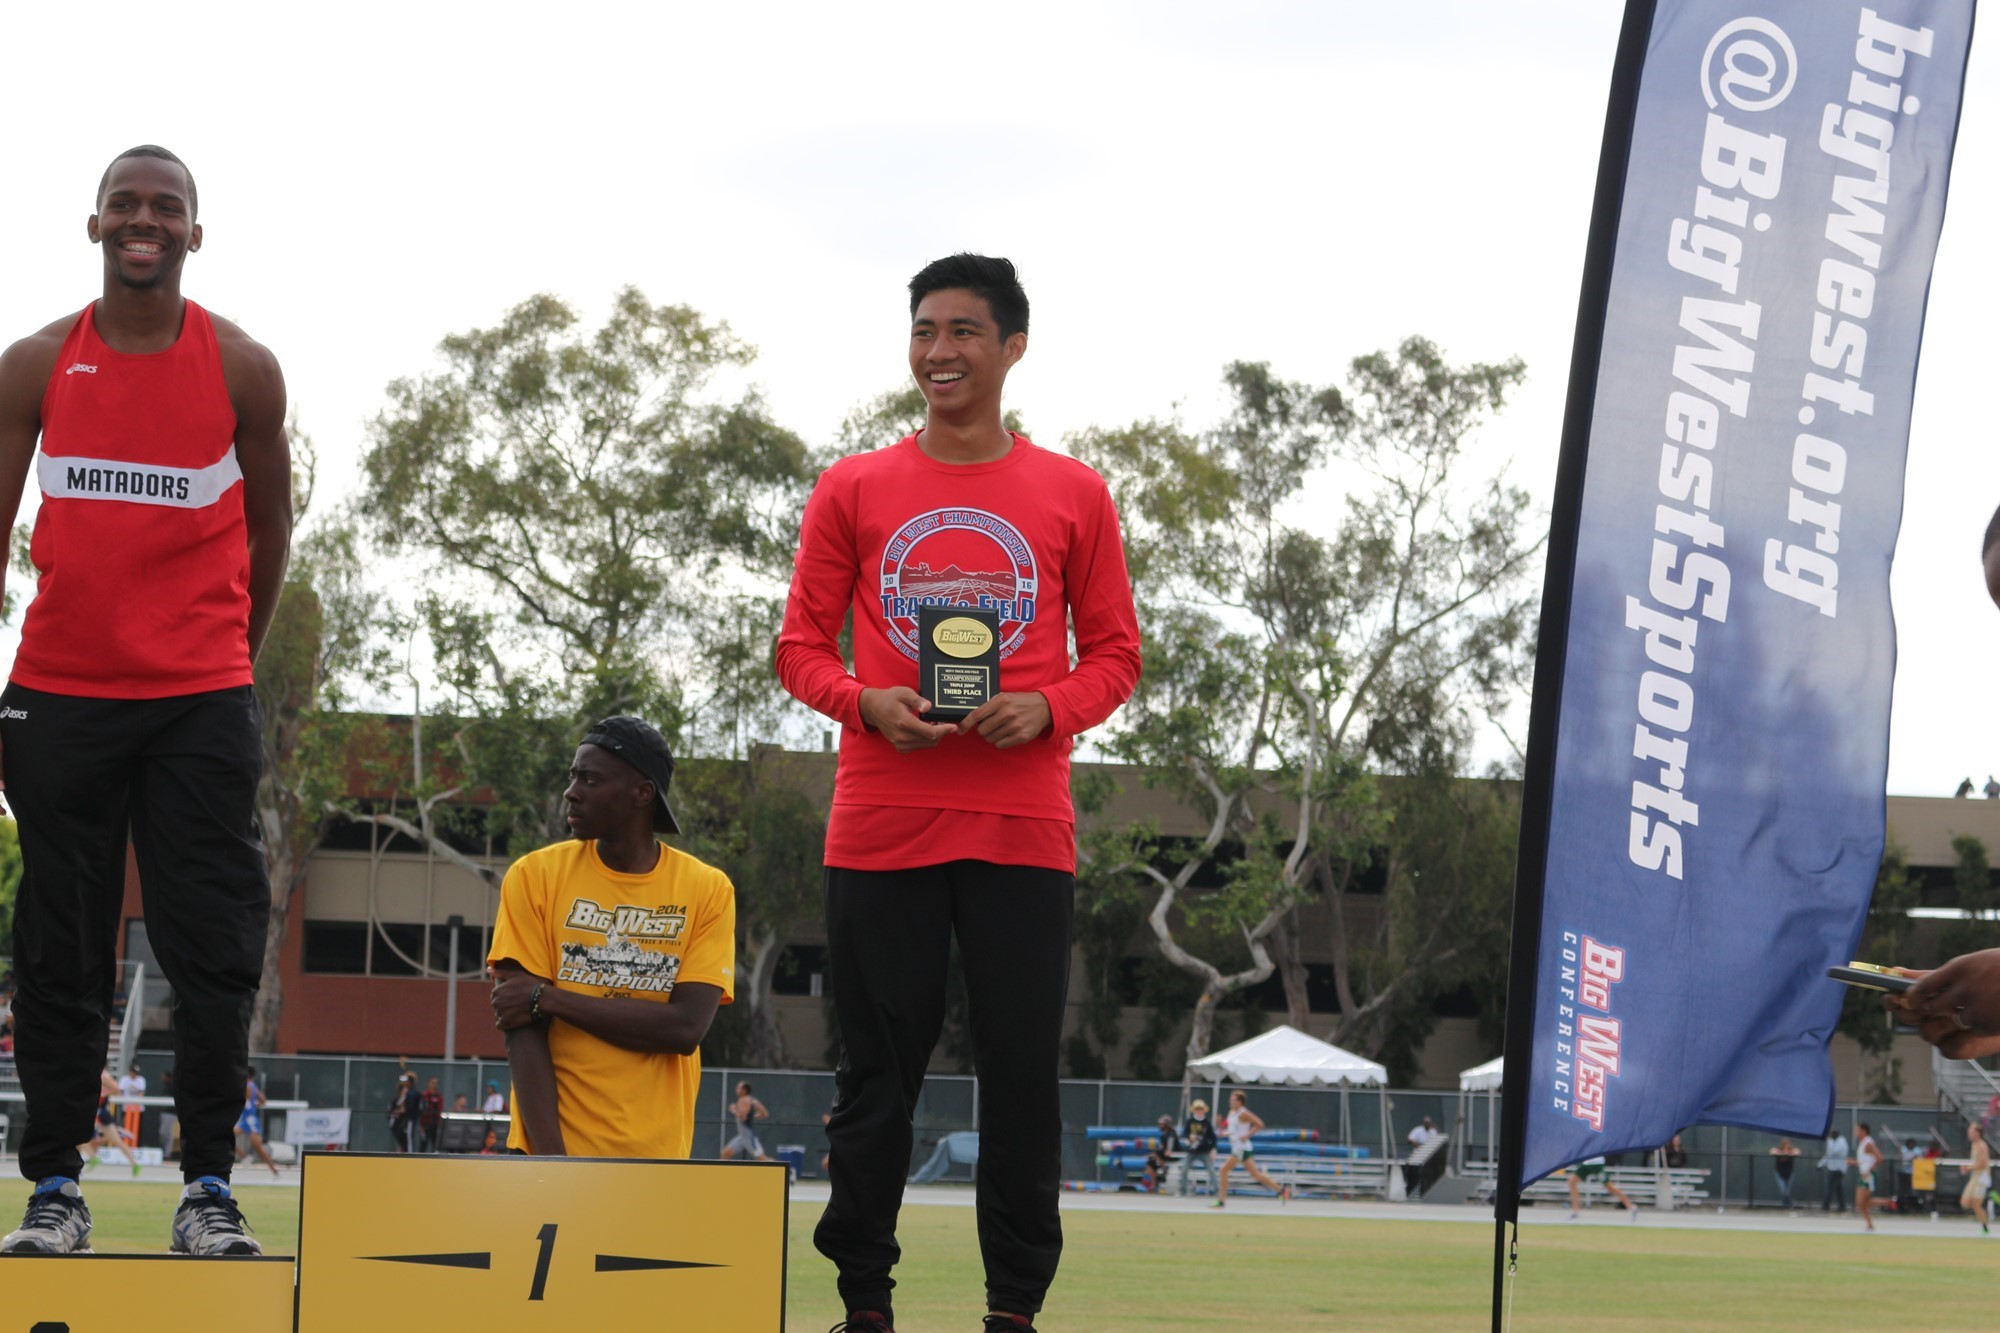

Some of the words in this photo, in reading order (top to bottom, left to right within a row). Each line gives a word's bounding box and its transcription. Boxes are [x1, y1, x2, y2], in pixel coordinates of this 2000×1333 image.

[1763, 6, 1935, 619] bigwest.org
[1625, 15, 1798, 881] @BigWestSports
[67, 466, 190, 500] MATADORS
[888, 539, 907, 562] BIG
[903, 516, 939, 540] WEST
[943, 512, 1030, 567] CHAMPIONSHIP
[884, 577, 894, 585] 20
[1022, 581, 1032, 590] 16
[899, 644, 919, 662] BEAC
[568, 900, 614, 931] BIG
[614, 907, 684, 937] WEST
[656, 905, 687, 915] 2014
[557, 967, 676, 993] CHAMPIONS
[1580, 936, 1625, 1013] BIG
[1554, 931, 1577, 1111] CONFERENCE
[1573, 1014, 1621, 1132] WEST
[528, 1223, 559, 1301] 1
